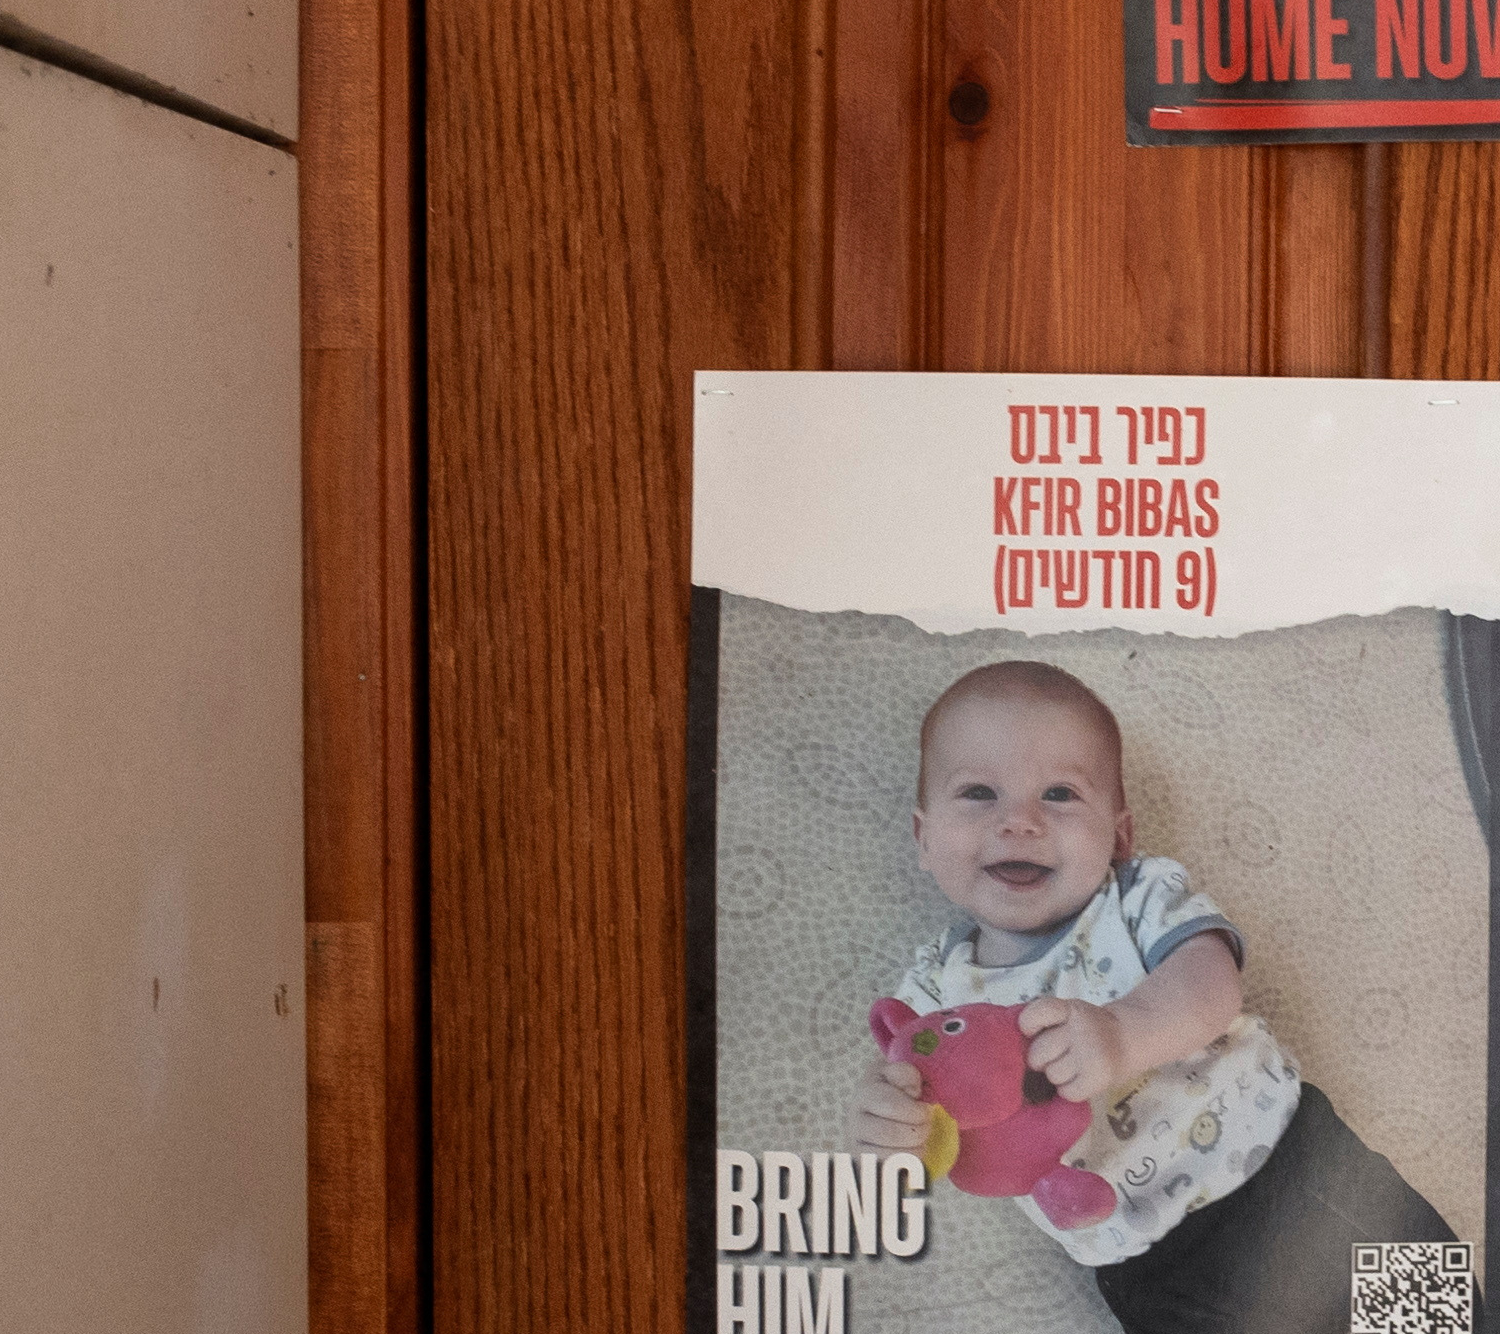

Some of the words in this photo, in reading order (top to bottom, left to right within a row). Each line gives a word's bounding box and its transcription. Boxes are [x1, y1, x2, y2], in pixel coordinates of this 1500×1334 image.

[1007, 404, 1103, 465] ביבס
[1115, 406, 1206, 466] כפיר
[993, 476, 1082, 537] KFIR
[1096, 477, 1220, 538] BIBAS
[717, 1147, 928, 1257] BRING
